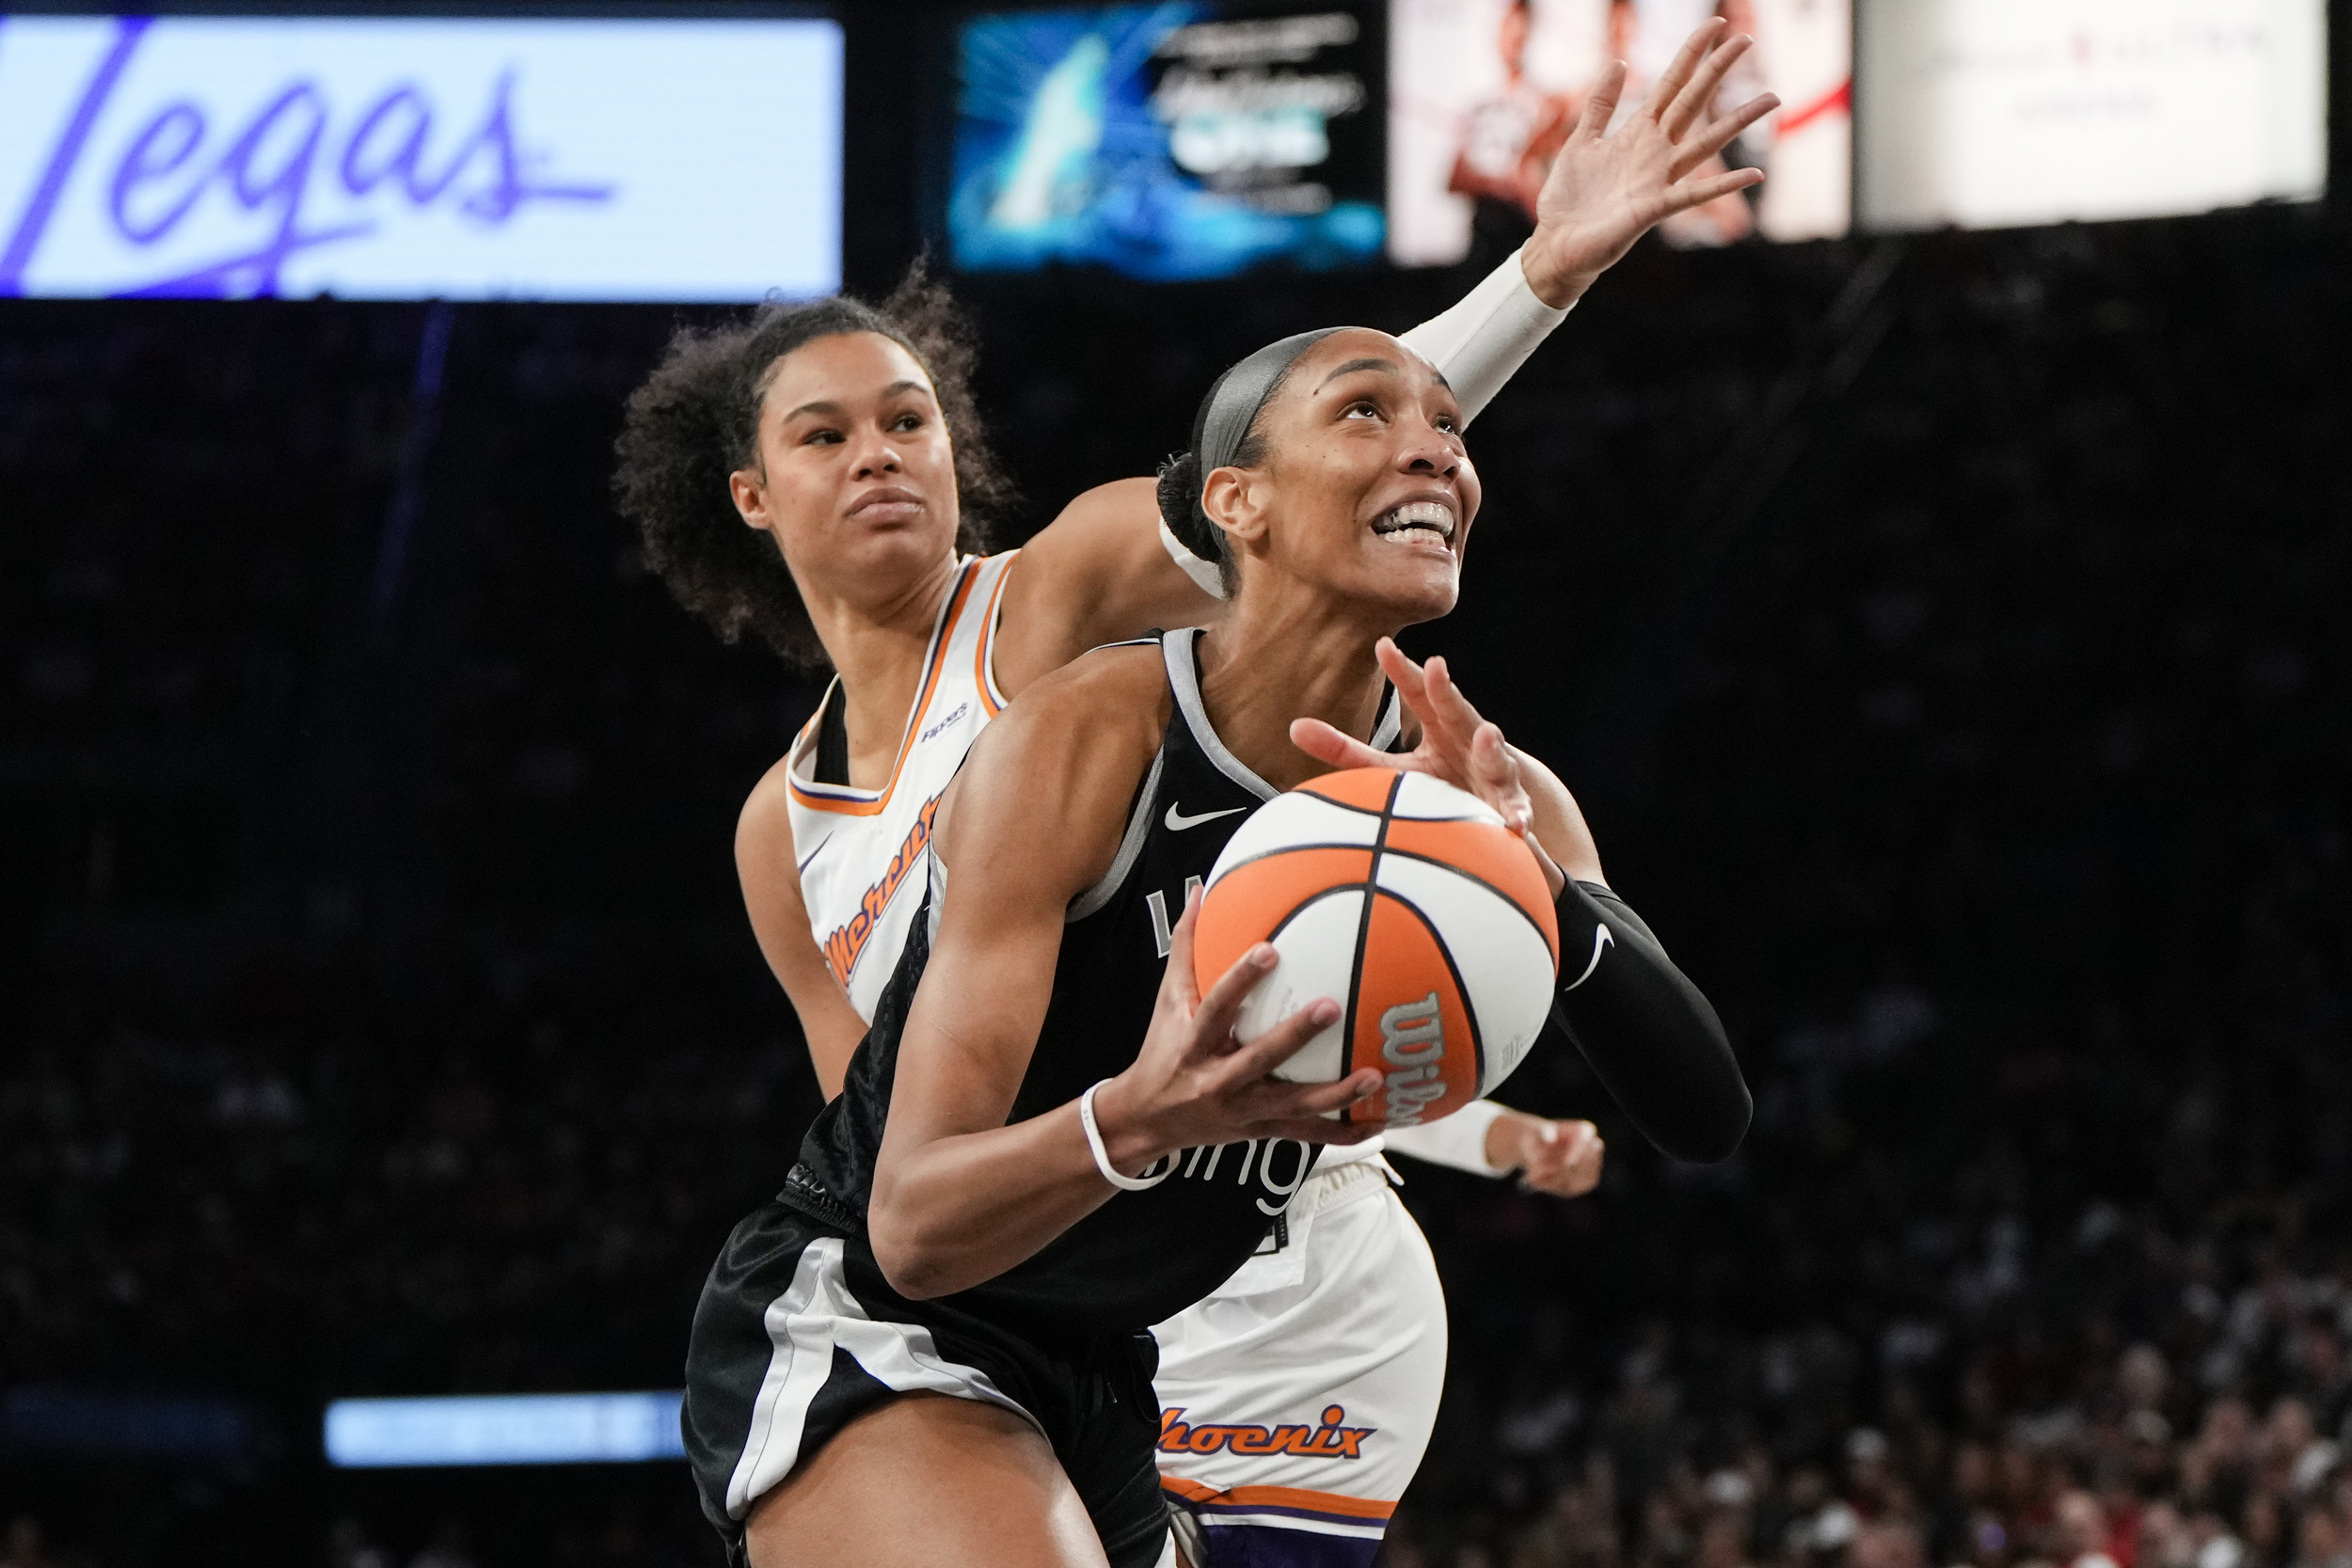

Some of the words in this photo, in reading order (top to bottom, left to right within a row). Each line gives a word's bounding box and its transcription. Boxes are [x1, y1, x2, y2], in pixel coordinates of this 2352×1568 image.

[823, 793, 944, 997] Mercur
[1379, 991, 1447, 1130] Wils
[1144, 1136, 1311, 1216] ing
[1155, 1404, 1378, 1459] hoenix
